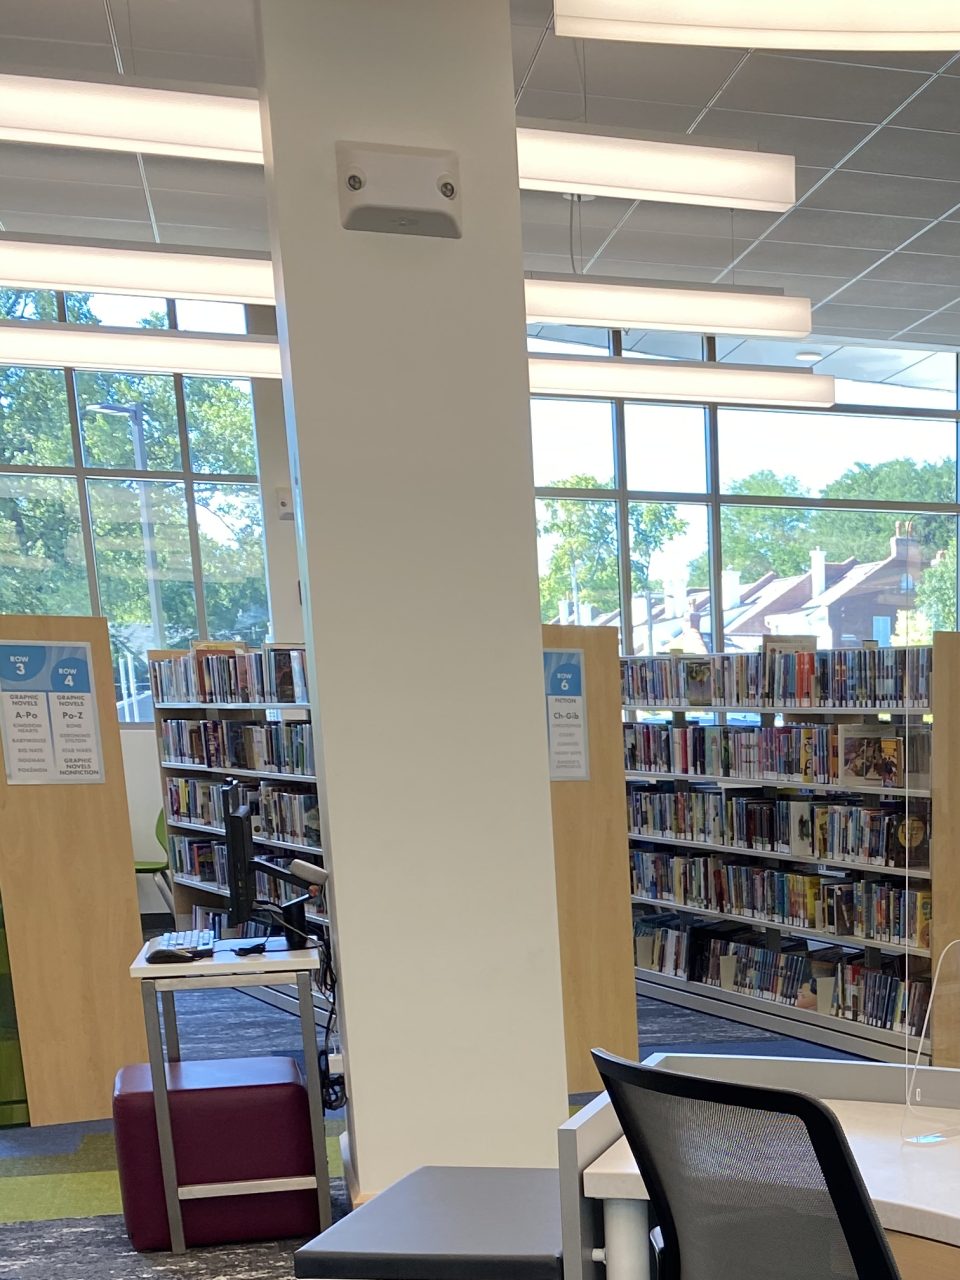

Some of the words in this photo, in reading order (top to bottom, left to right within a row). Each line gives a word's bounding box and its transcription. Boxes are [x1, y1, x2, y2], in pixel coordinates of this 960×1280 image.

[16, 663, 26, 675] 3
[64, 675, 74, 687] 4
[561, 680, 569, 690] 6
